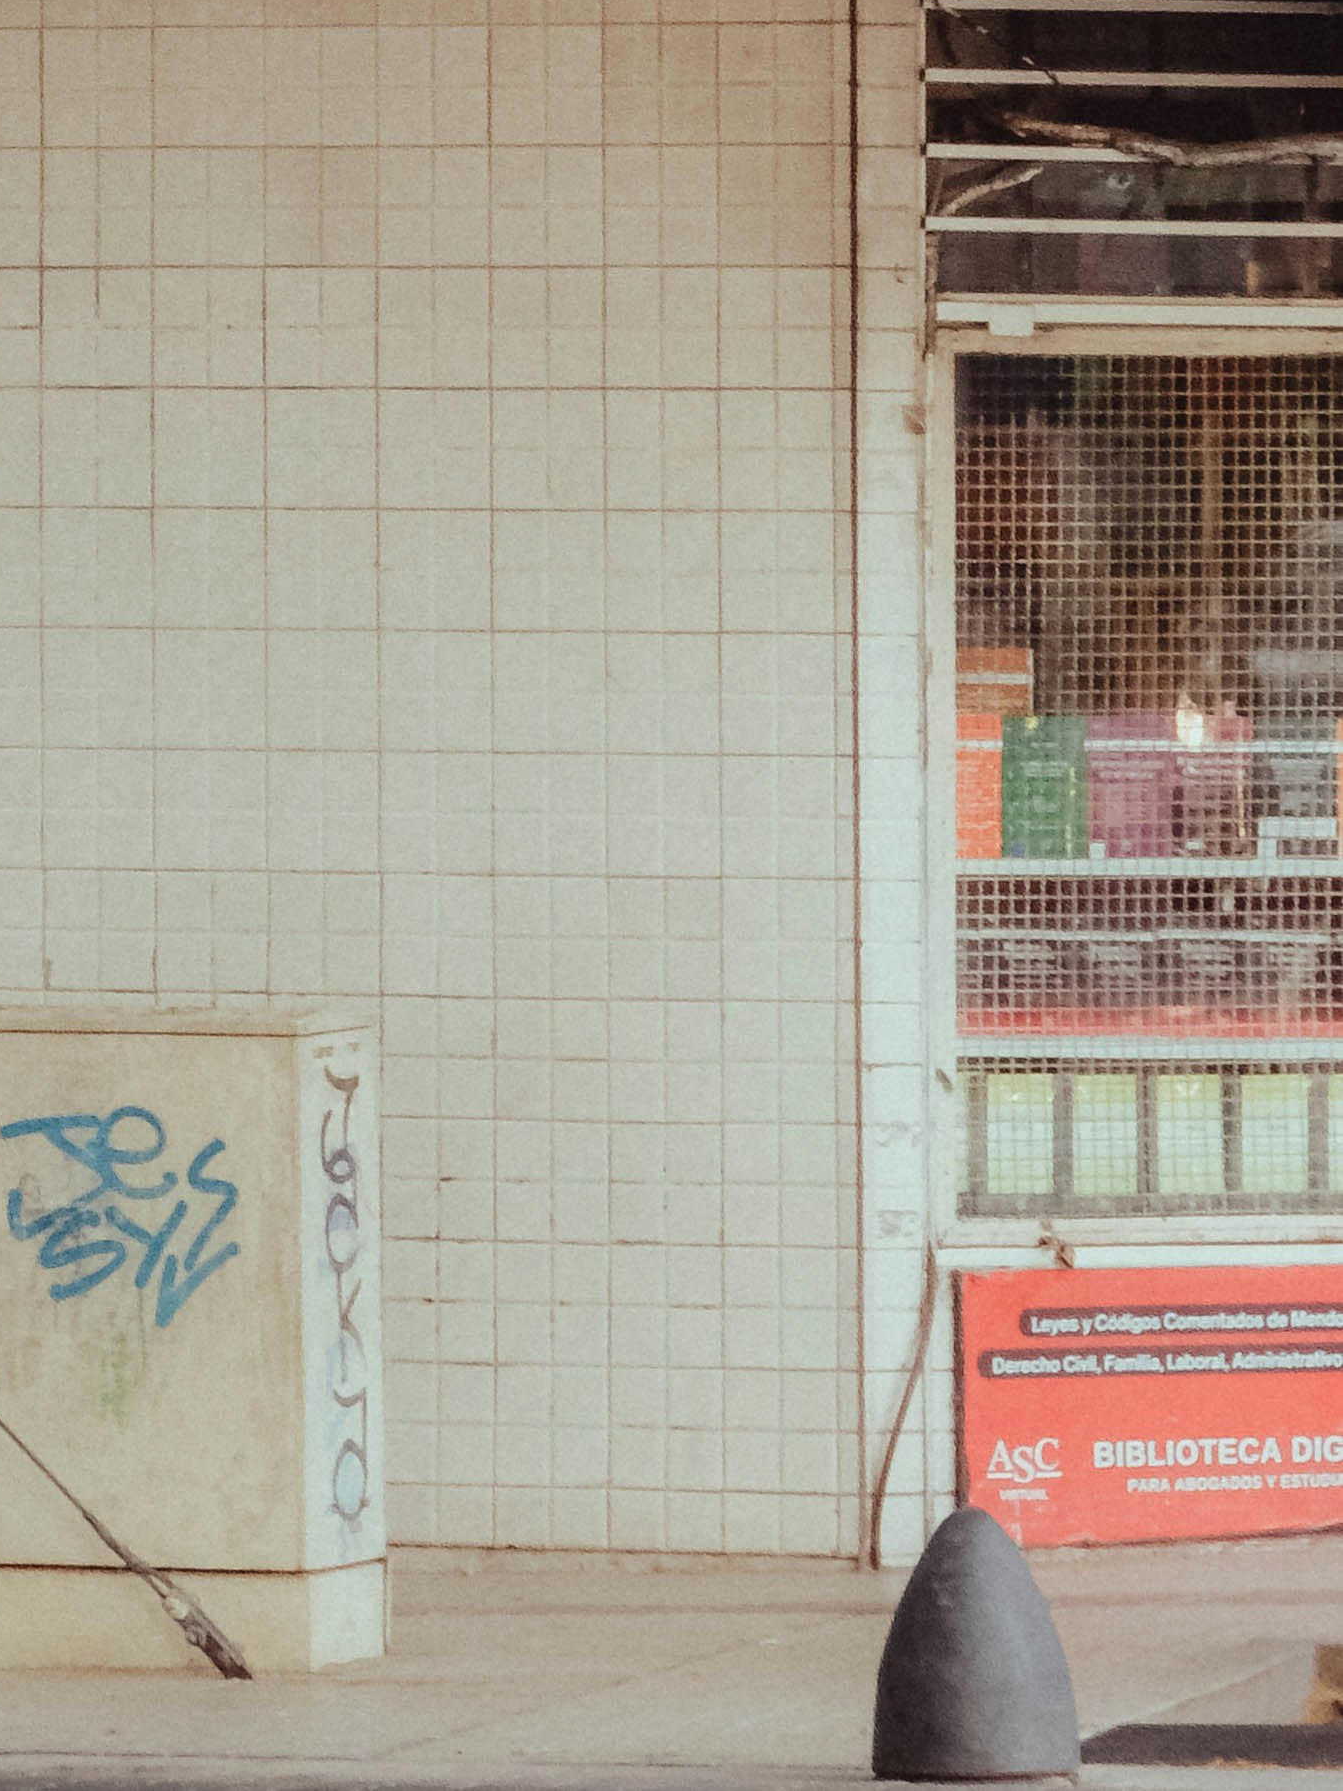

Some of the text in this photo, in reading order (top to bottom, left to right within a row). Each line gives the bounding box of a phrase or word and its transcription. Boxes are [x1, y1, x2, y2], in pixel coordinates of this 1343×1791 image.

[1030, 1316, 1080, 1336] Leyes
[1082, 1318, 1093, 1336] y
[1267, 1311, 1289, 1329] de
[992, 1356, 1062, 1375] Derecho
[987, 1437, 1060, 1483] ASC
[1093, 1437, 1282, 1468] BIBLIOTECA
[1127, 1478, 1171, 1493] PARA
[1174, 1475, 1264, 1492] ABOGADOS
[1266, 1474, 1278, 1489] Y
